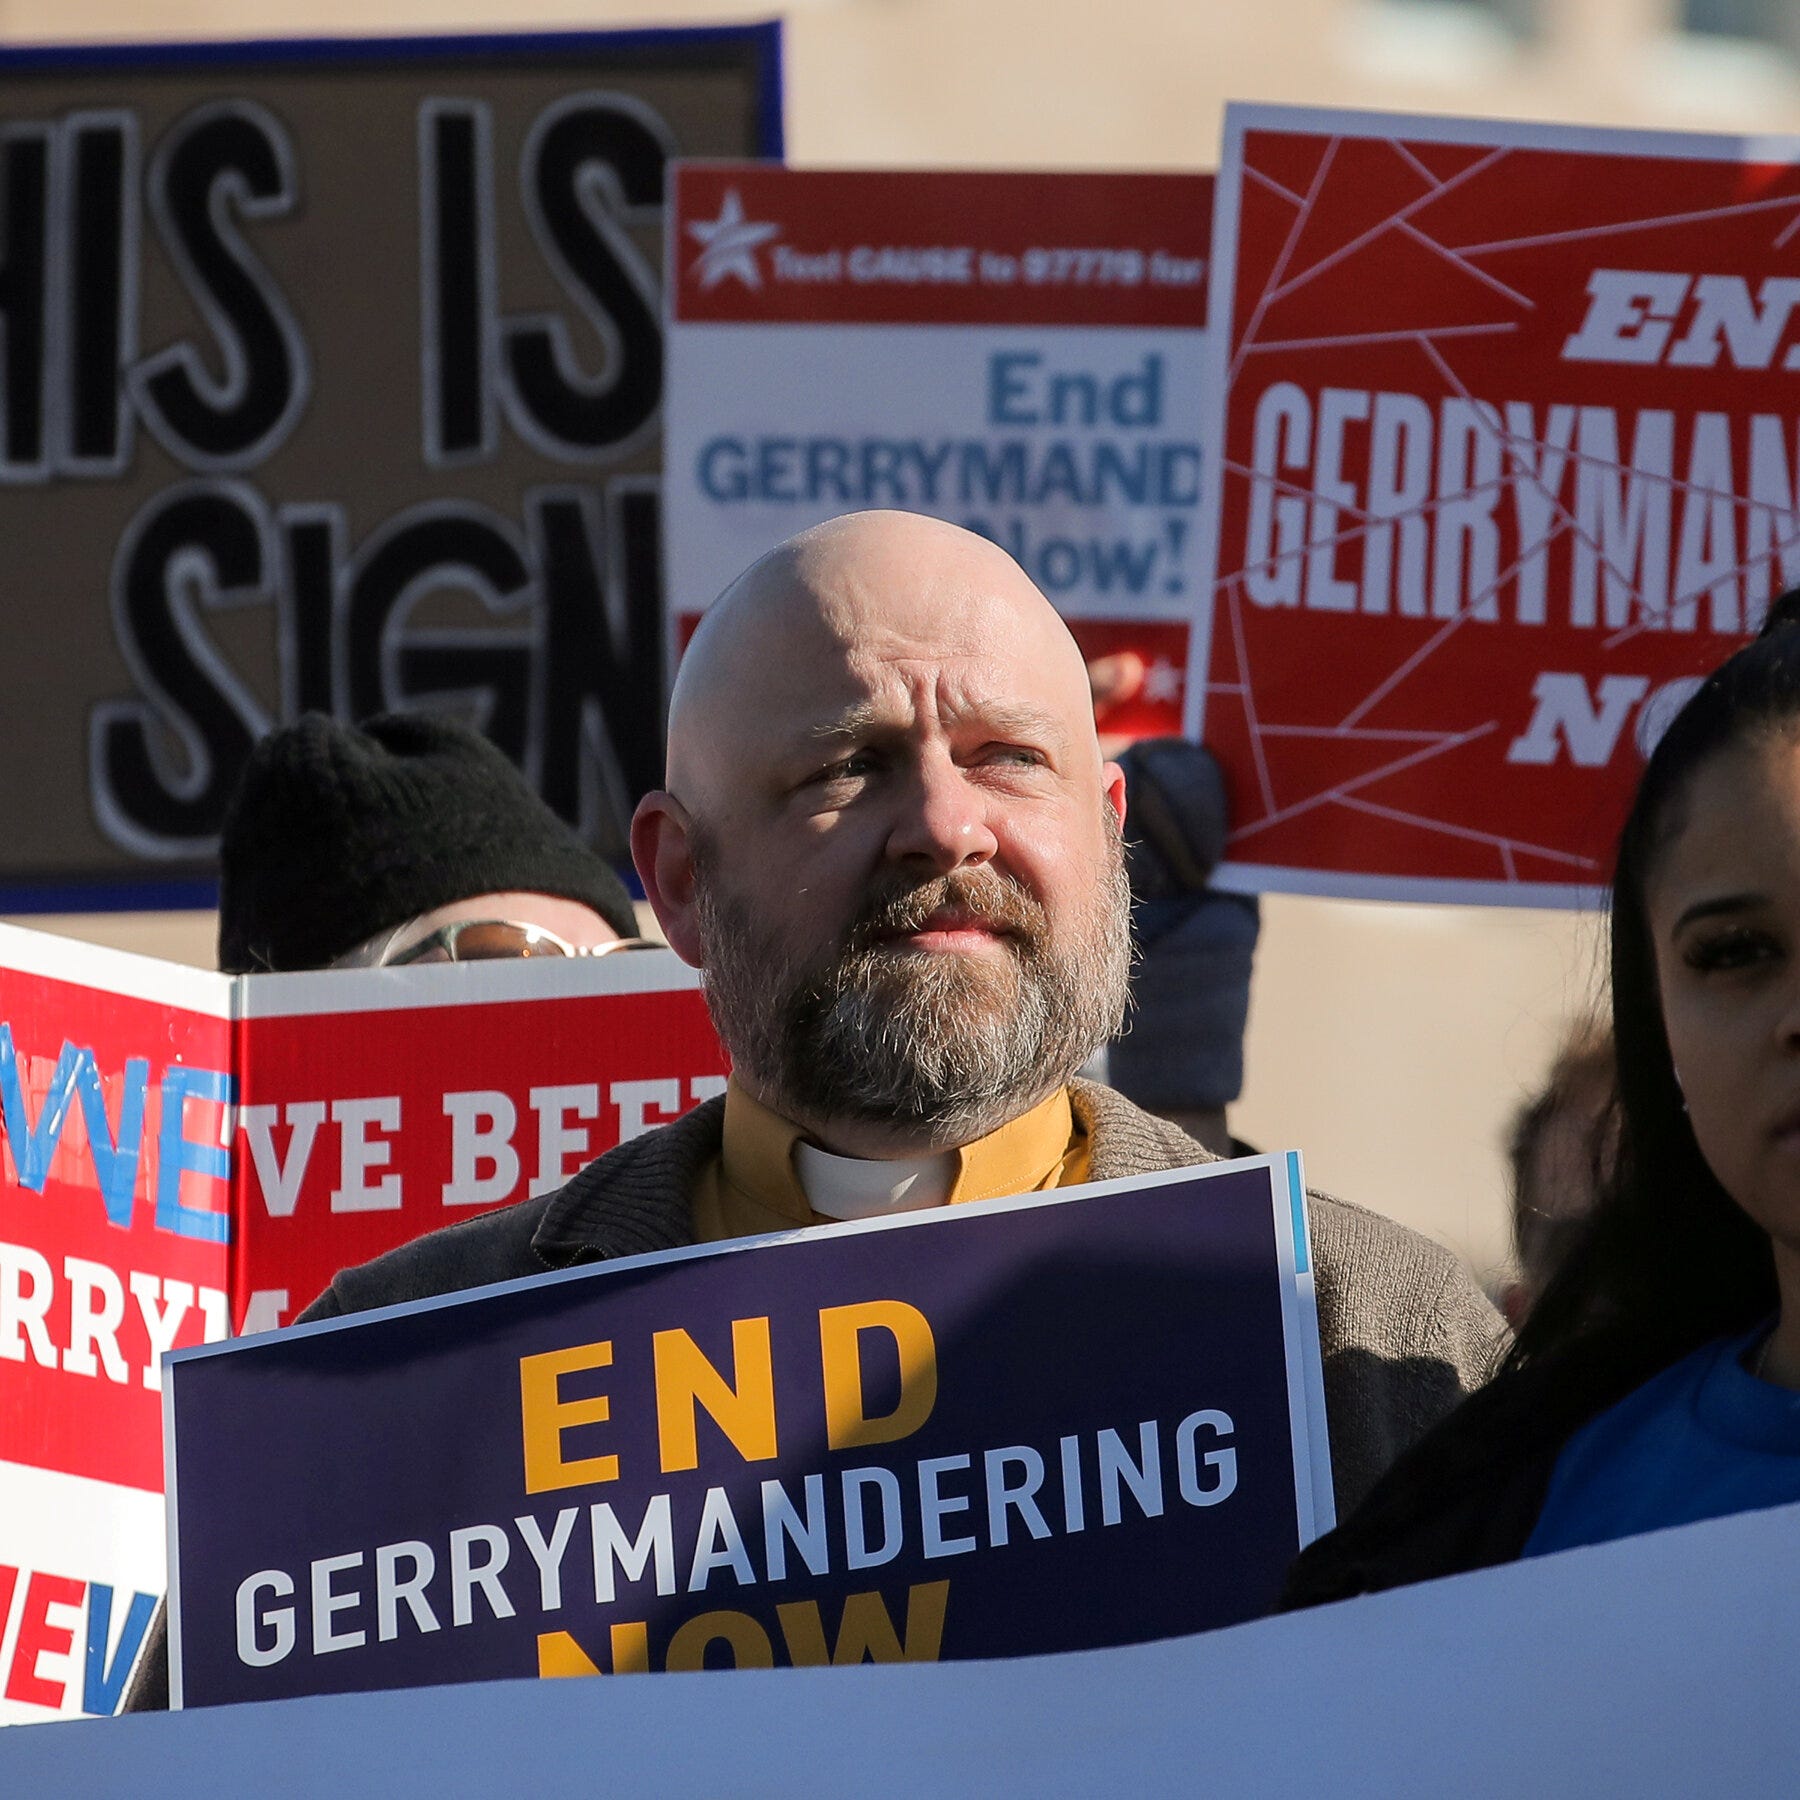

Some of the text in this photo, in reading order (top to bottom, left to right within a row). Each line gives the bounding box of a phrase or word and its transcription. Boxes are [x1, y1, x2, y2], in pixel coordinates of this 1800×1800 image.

[418, 91, 665, 469] IS
[1561, 267, 1800, 372] EN
[986, 350, 1165, 427] End
[441, 1075, 728, 1206] BEE
[519, 1299, 938, 1495] END
[235, 1408, 1239, 1668] GERRYMANDERING
